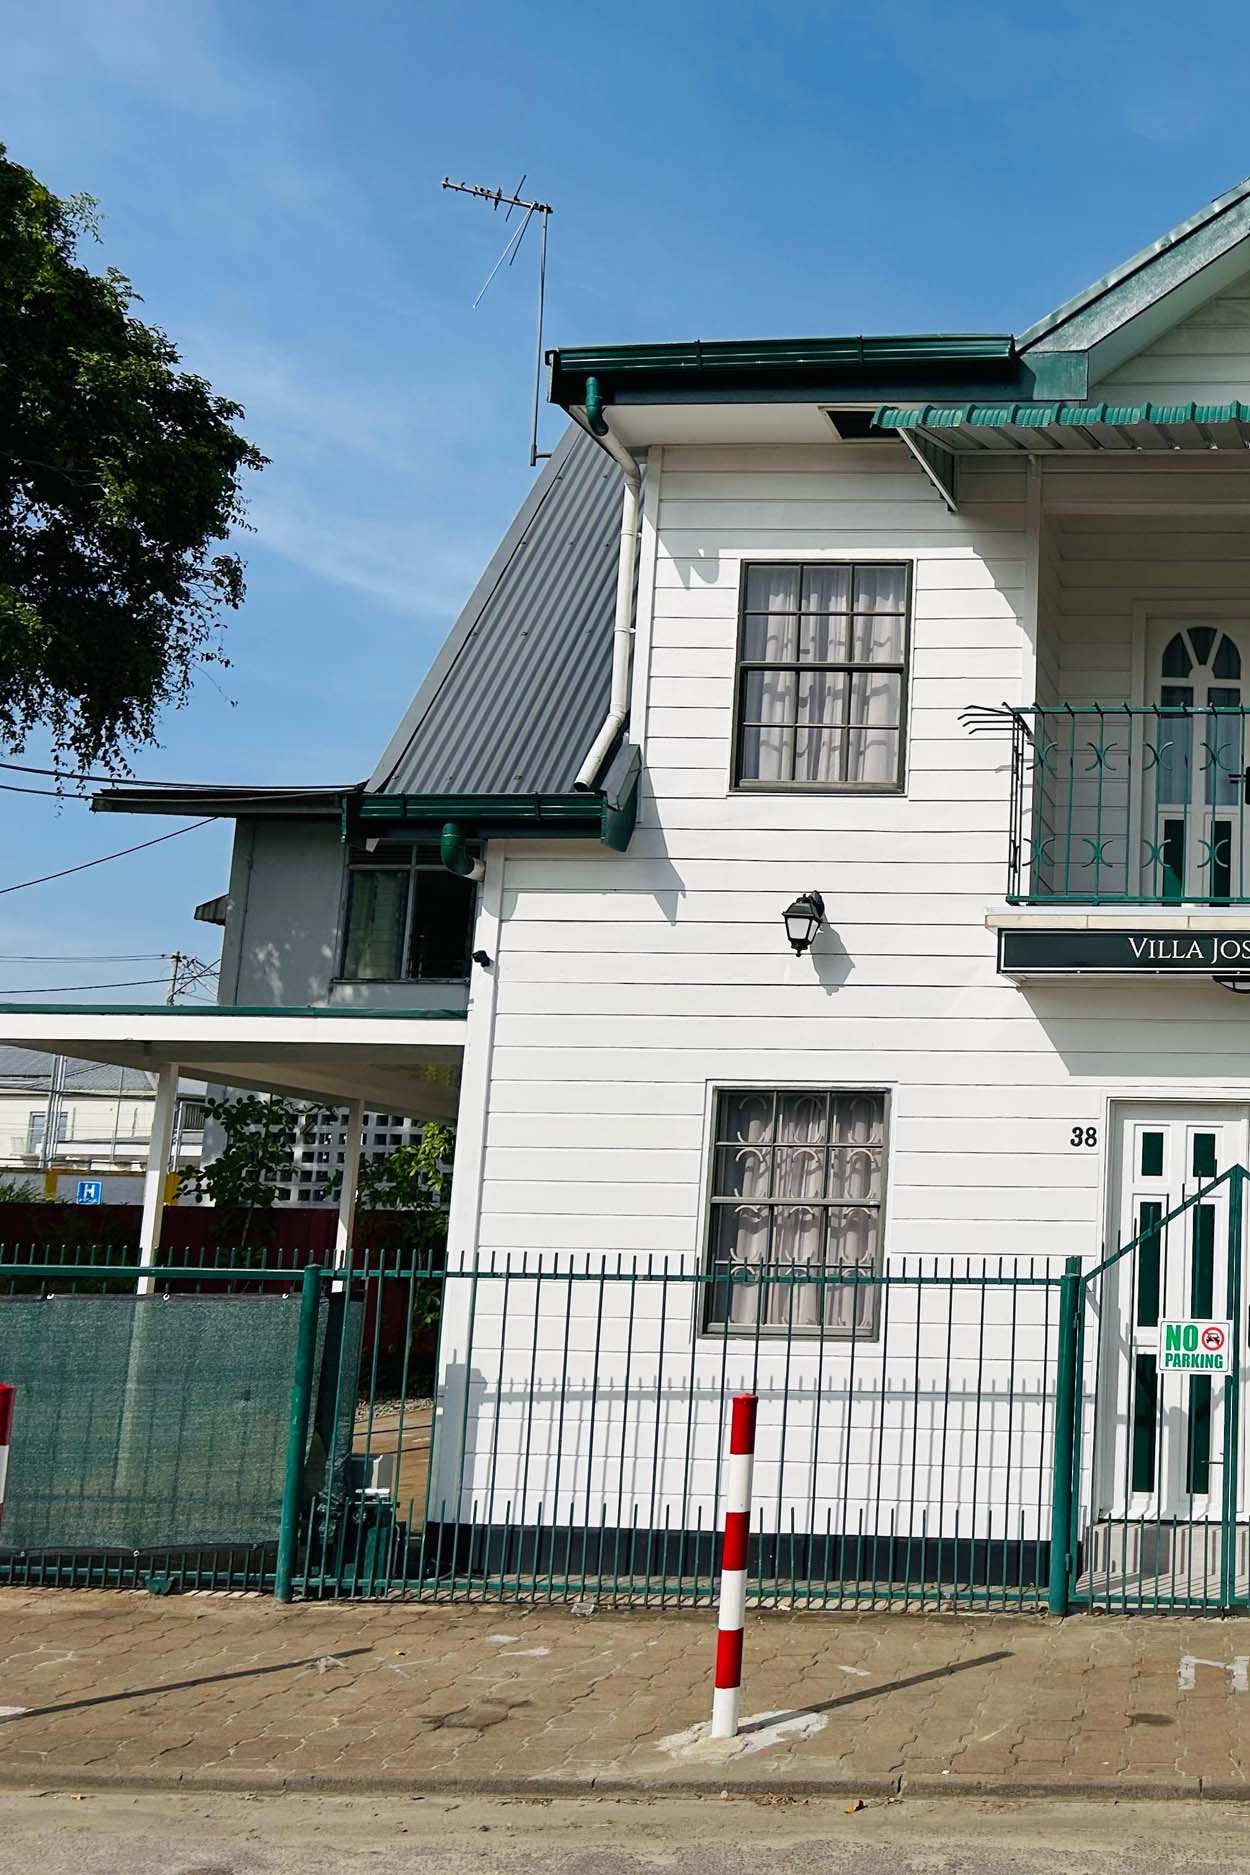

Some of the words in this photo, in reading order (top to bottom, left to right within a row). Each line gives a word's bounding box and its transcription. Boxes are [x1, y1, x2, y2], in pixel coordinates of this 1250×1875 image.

[1070, 1126, 1098, 1148] 38
[1166, 1325, 1199, 1352] NO
[1164, 1353, 1223, 1369] PARKING
